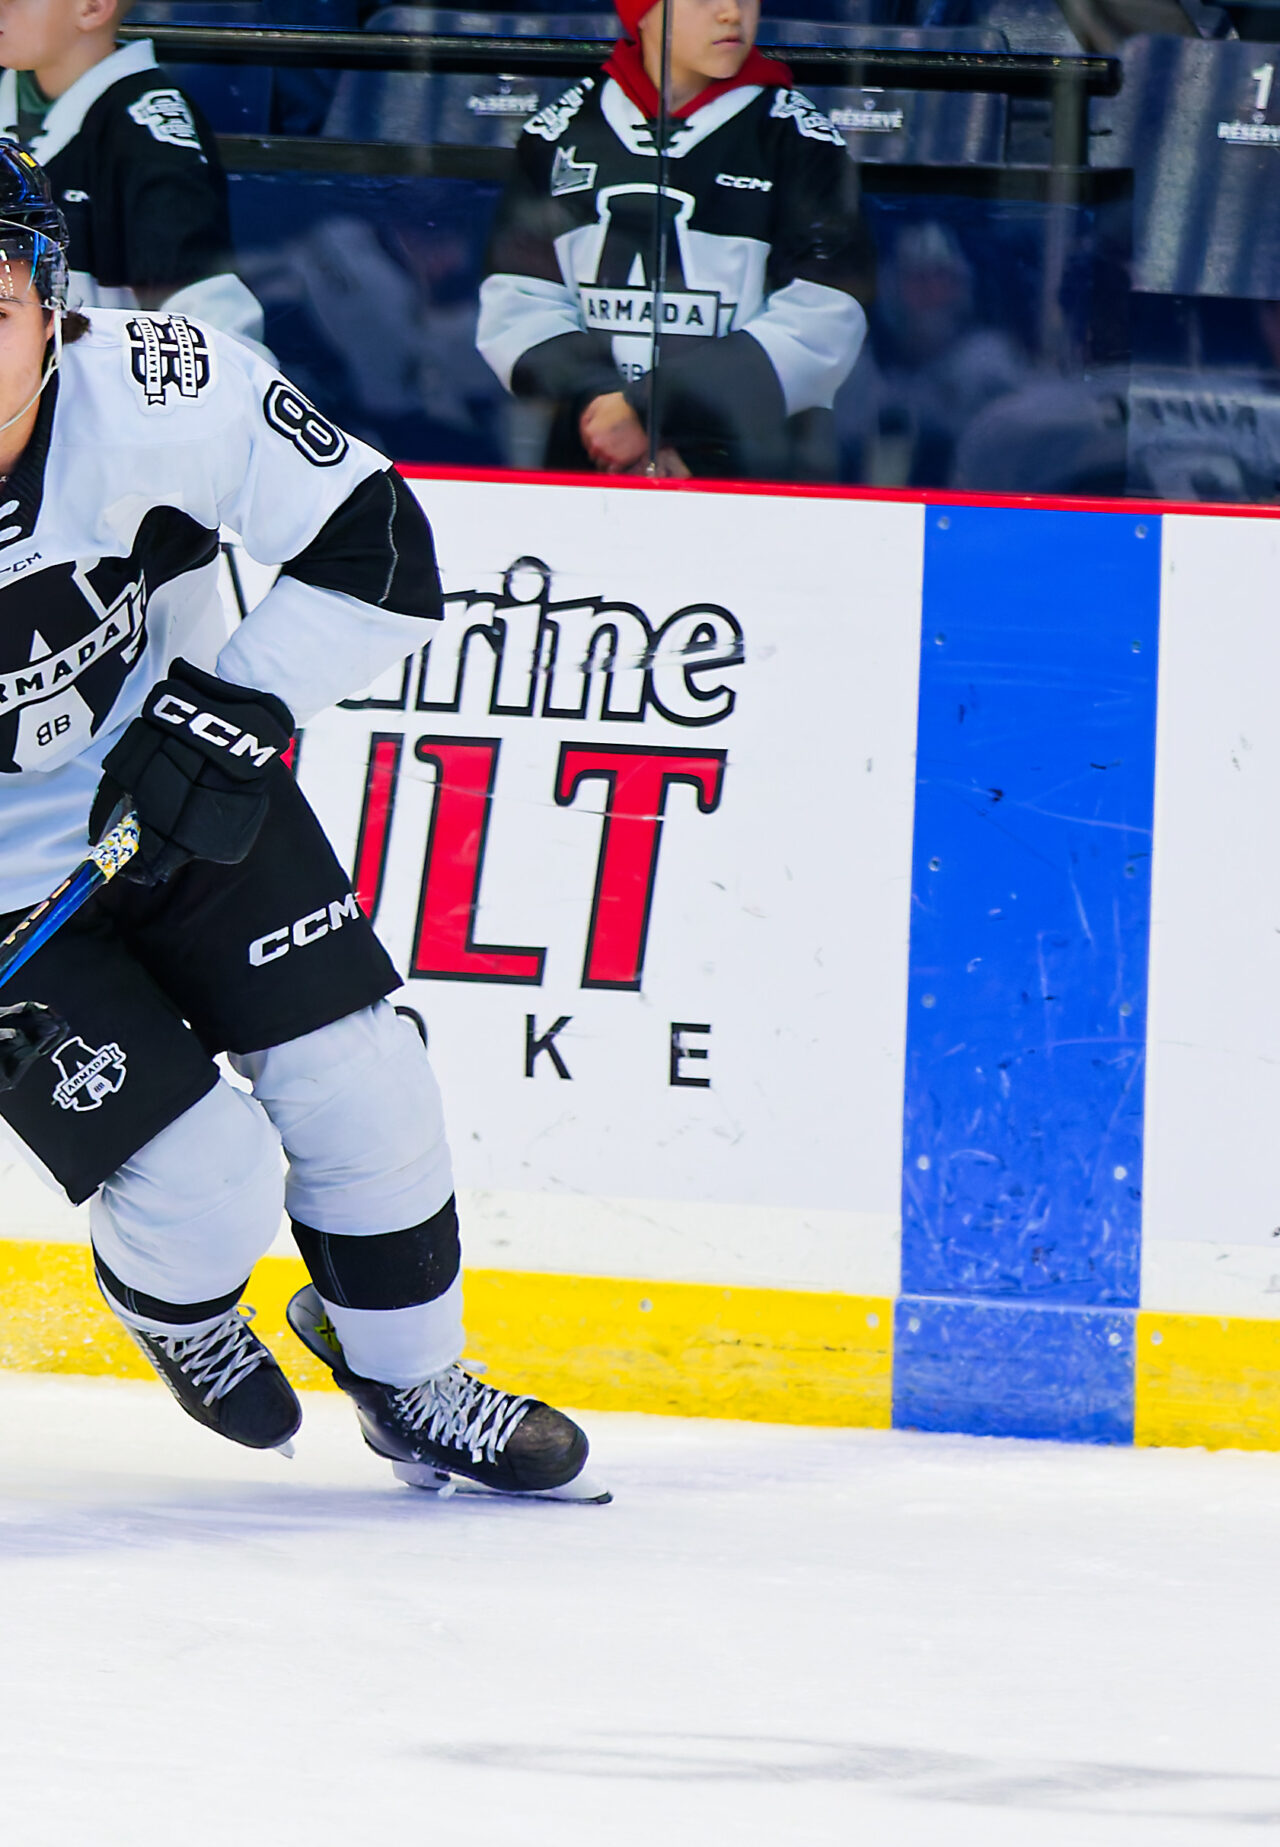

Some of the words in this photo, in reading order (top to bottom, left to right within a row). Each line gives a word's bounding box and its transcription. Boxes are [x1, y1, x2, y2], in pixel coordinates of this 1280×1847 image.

[1251, 62, 1274, 109] 1
[1217, 119, 1280, 141] RÉSERV
[587, 297, 704, 326] ARMADA
[264, 380, 349, 467] 8
[153, 694, 279, 767] CCM
[249, 892, 361, 967] CCM
[67, 1055, 109, 1092] ARMADA
